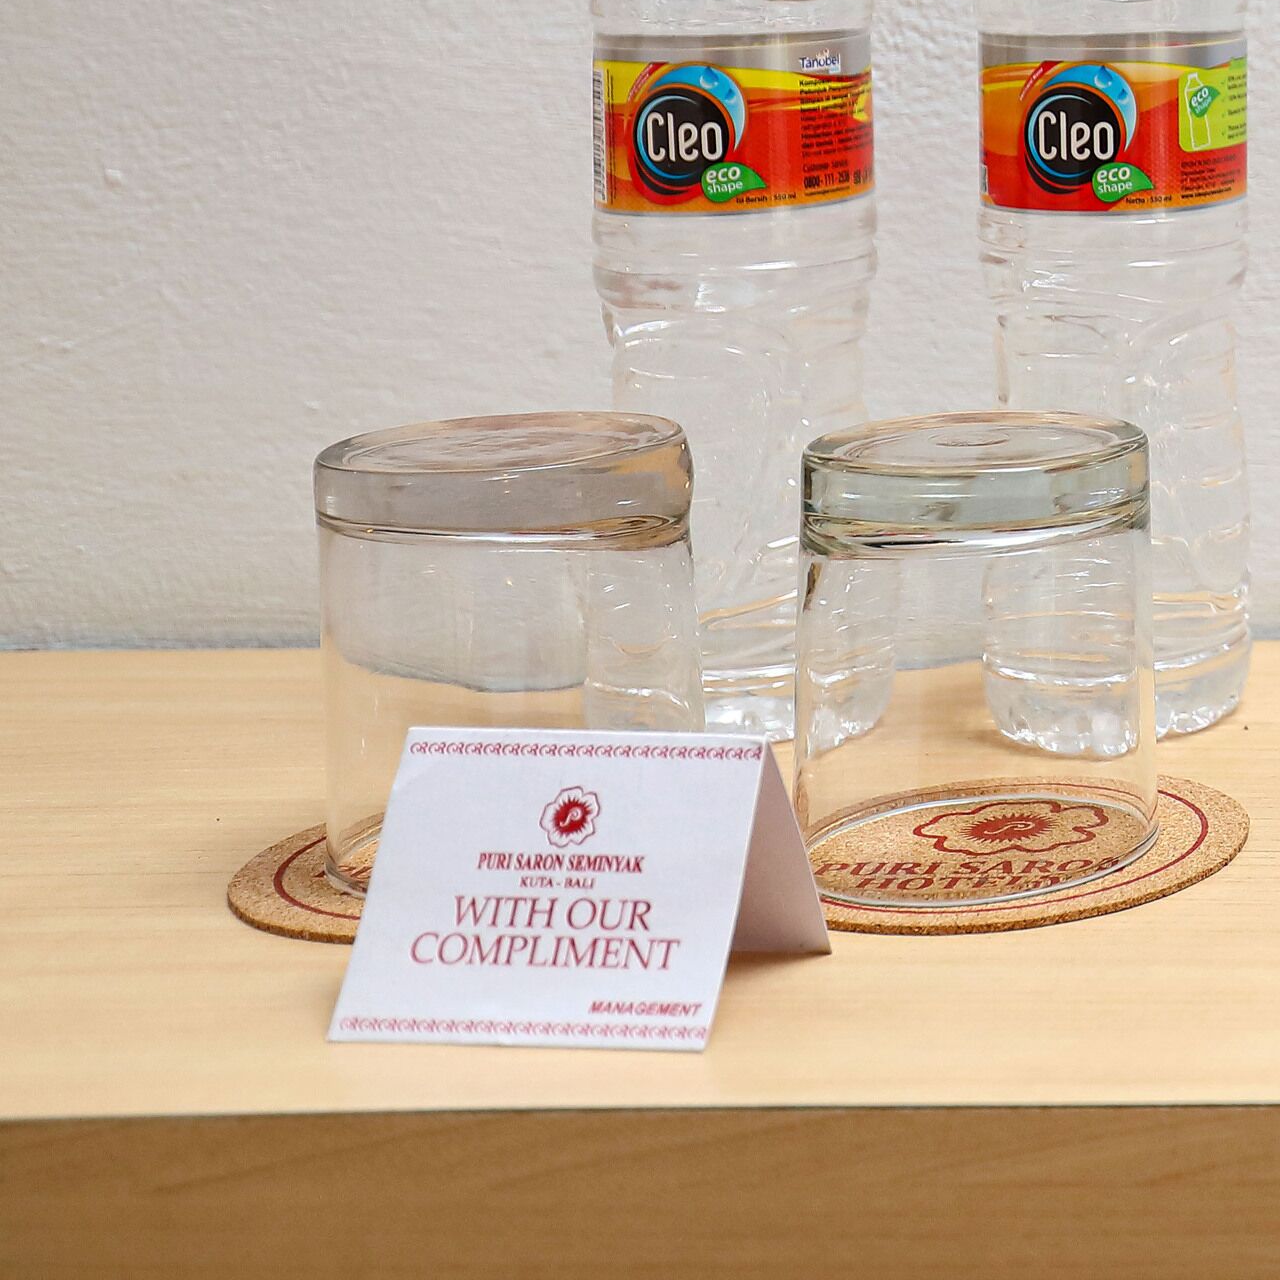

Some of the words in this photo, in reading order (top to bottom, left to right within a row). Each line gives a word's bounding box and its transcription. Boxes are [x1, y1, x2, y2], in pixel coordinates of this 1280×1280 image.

[1191, 87, 1209, 107] eco
[647, 112, 723, 162] Cleo
[1038, 110, 1114, 160] Cleo
[705, 166, 741, 183] eco
[1096, 167, 1131, 183] eco
[707, 180, 743, 194] shape
[1097, 180, 1133, 194] shape
[477, 852, 512, 869] PURI
[514, 853, 565, 871] SARON
[567, 854, 644, 872] SEMINYAK
[814, 861, 942, 876] PURI
[520, 876, 553, 888] KUTA
[564, 877, 596, 889] BALI
[454, 895, 558, 929] WITH
[566, 897, 652, 931] OUR
[410, 932, 680, 970] COMPLIMENT
[588, 1000, 702, 1017] MANAGEMENT
